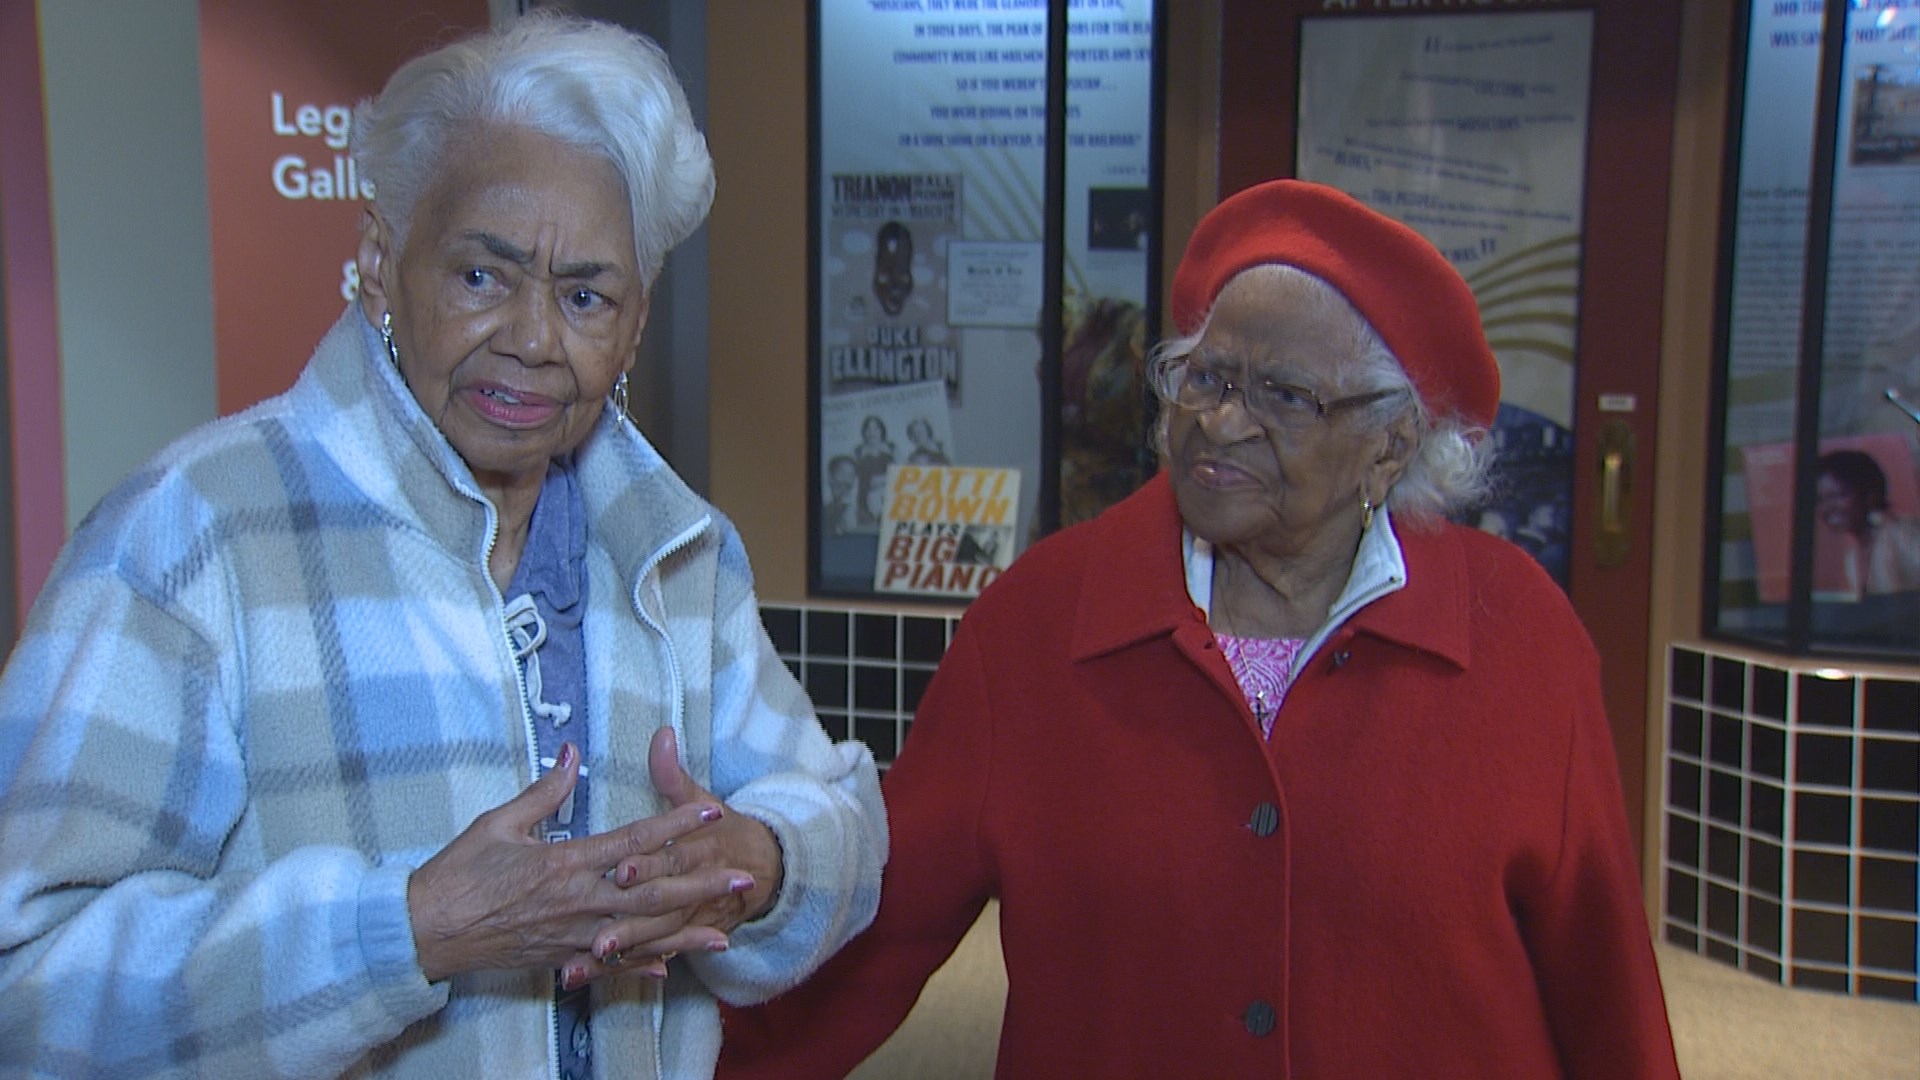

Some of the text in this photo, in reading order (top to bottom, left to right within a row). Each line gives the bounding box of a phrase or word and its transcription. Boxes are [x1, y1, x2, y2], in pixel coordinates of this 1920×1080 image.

[867, 326, 920, 345] DUKE
[831, 347, 958, 384] ELLINGTON
[894, 466, 1008, 497] PATTI
[889, 495, 1010, 525] BOWN
[895, 520, 960, 536] PLAYS
[886, 534, 956, 563] BIG
